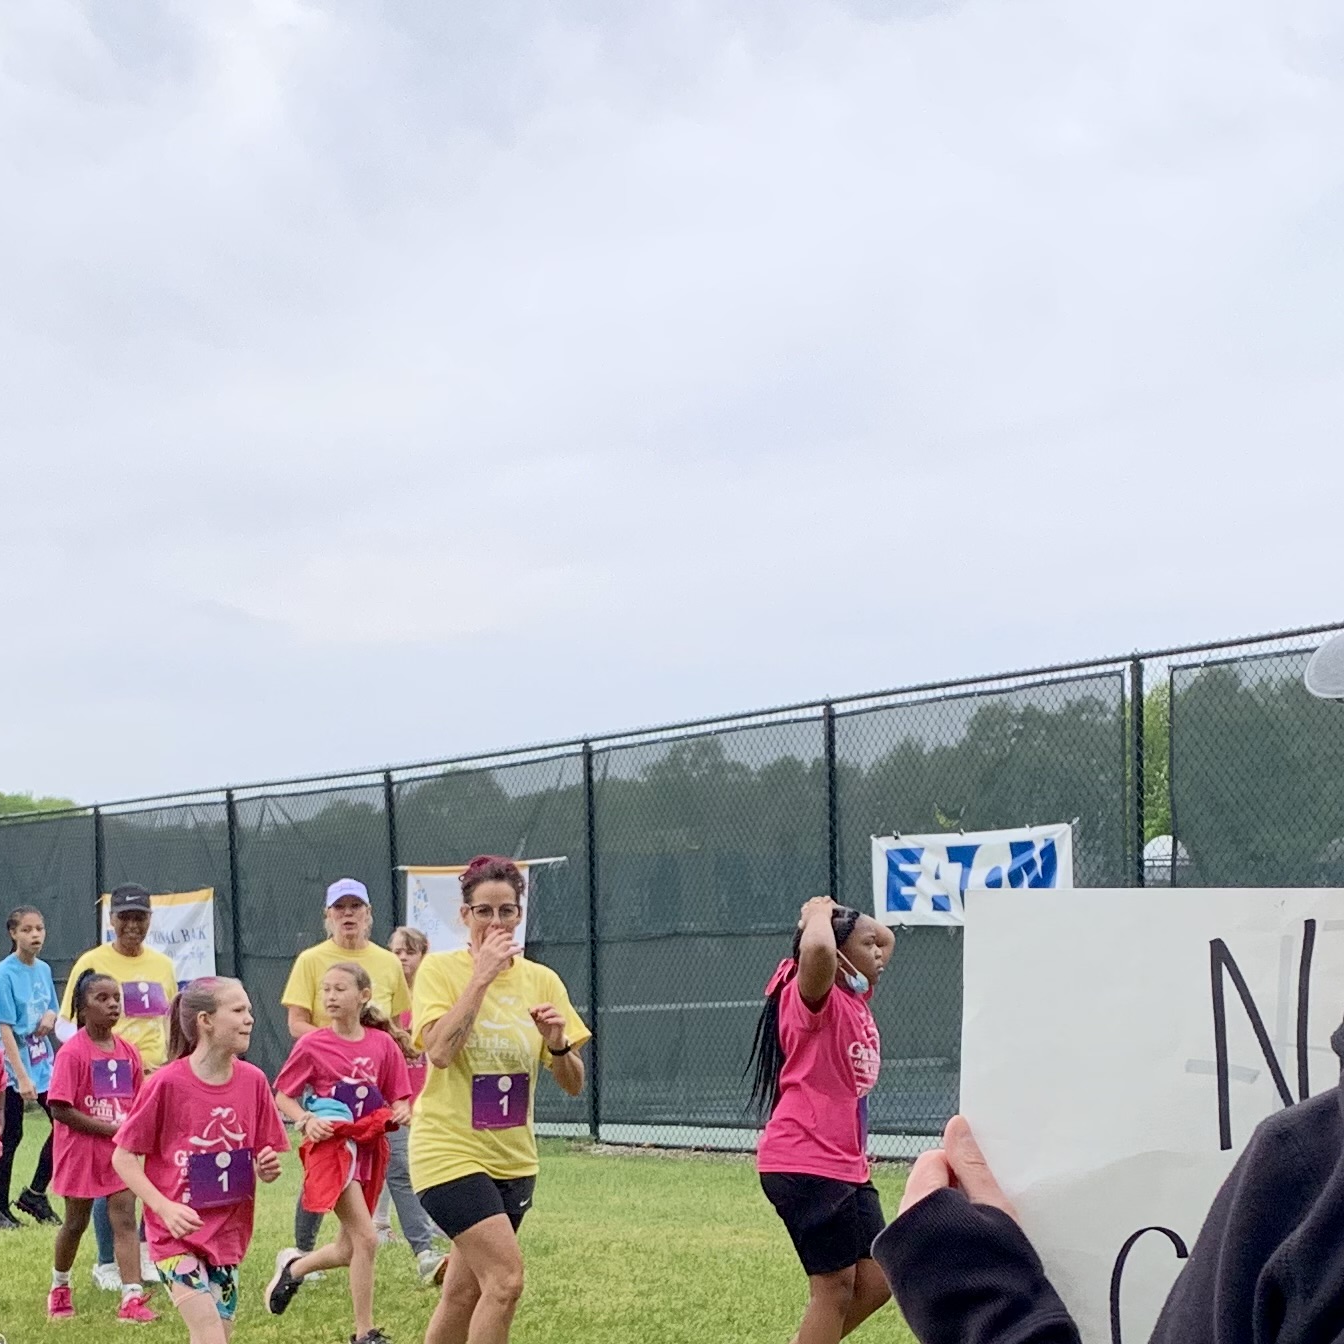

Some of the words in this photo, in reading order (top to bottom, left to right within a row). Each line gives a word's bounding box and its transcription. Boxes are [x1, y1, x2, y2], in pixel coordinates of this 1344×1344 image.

[886, 838, 1058, 912] EATON
[141, 993, 149, 1009] 1
[110, 1072, 117, 1089] 1
[356, 1101, 364, 1117] 1
[499, 1095, 509, 1116] 1
[218, 1171, 229, 1192] 1
